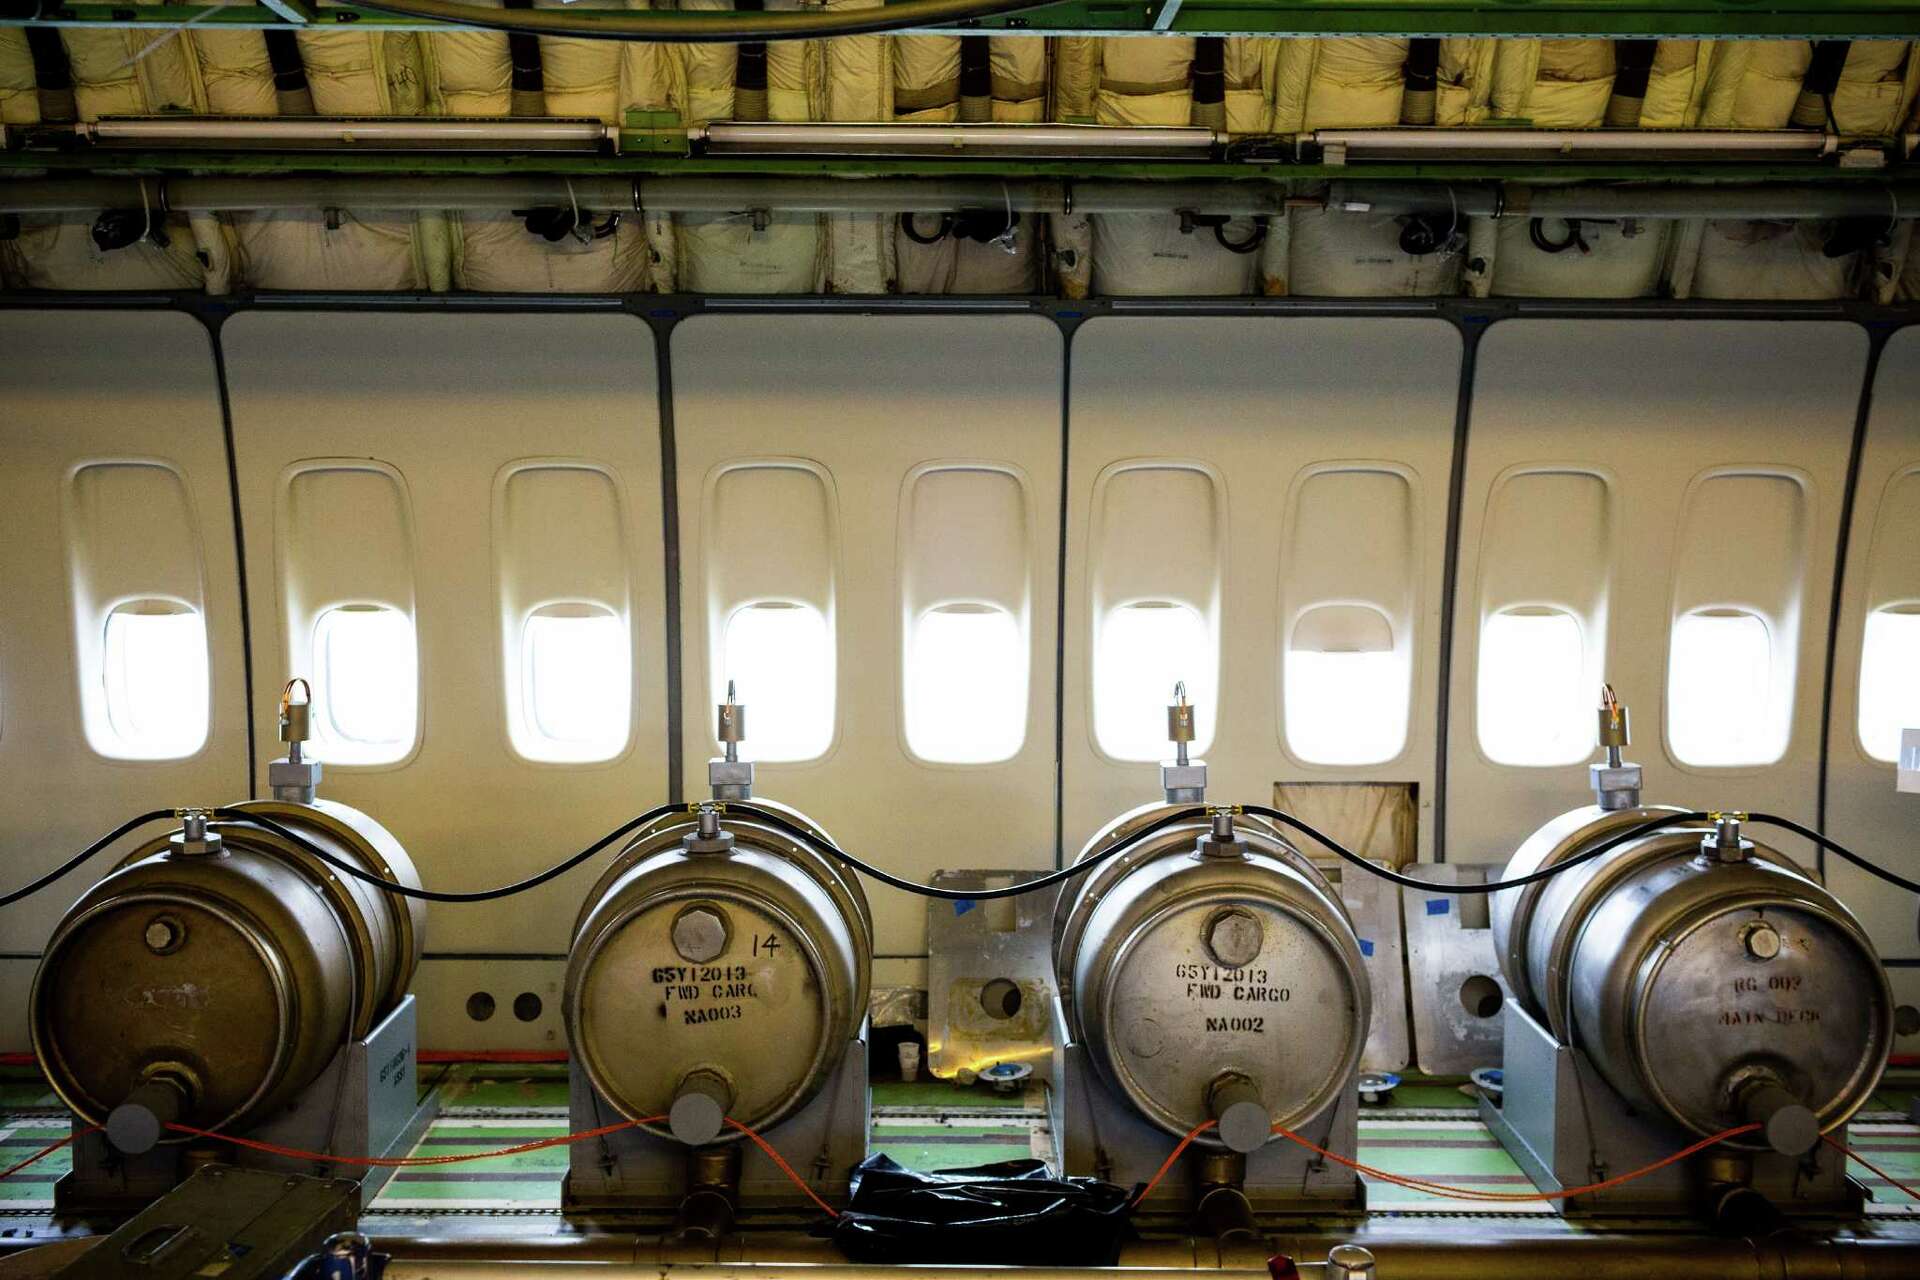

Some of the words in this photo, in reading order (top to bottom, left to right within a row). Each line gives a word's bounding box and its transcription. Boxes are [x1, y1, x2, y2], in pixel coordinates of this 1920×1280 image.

[752, 933, 781, 957] 14
[665, 985, 700, 1000] FWD
[1187, 983, 1221, 999] FWD
[1233, 986, 1290, 1002] CARGO
[684, 1004, 742, 1025] NA003
[1206, 1016, 1265, 1033] NA002
